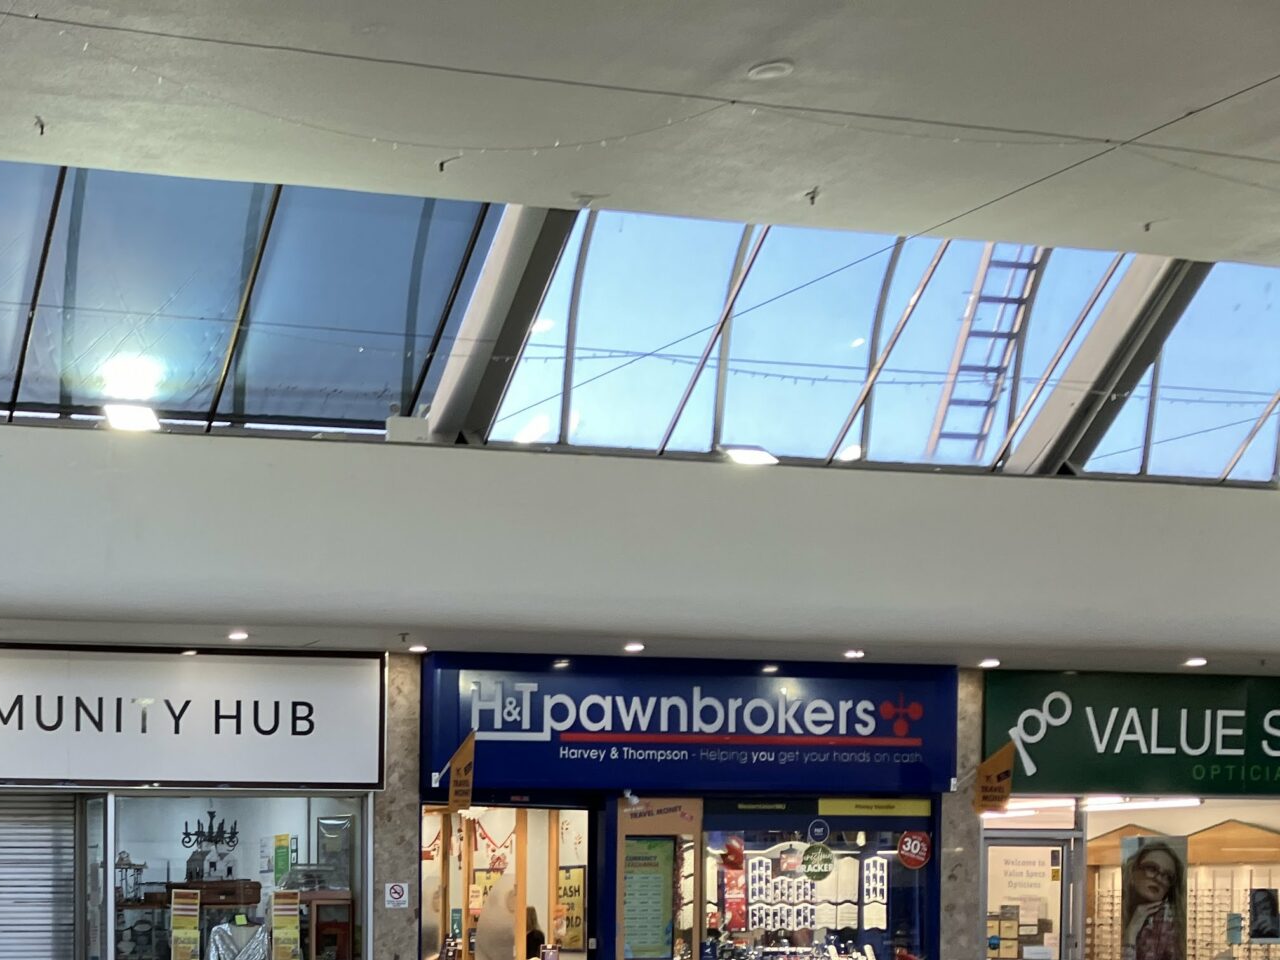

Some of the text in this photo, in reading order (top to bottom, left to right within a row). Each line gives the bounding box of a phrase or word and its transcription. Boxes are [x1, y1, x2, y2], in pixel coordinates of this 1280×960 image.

[214, 700, 317, 736] HUB
[542, 685, 877, 741] pawnbrokers
[1085, 706, 1246, 756] VALUE
[559, 746, 607, 761] Harvey
[609, 747, 619, 759] &
[622, 747, 689, 762] Thompson
[700, 749, 748, 764] Helping
[751, 750, 775, 763] you
[778, 751, 800, 764] get
[803, 752, 831, 764] your
[833, 750, 871, 763] hands
[874, 753, 890, 763] on
[893, 751, 923, 764] cash
